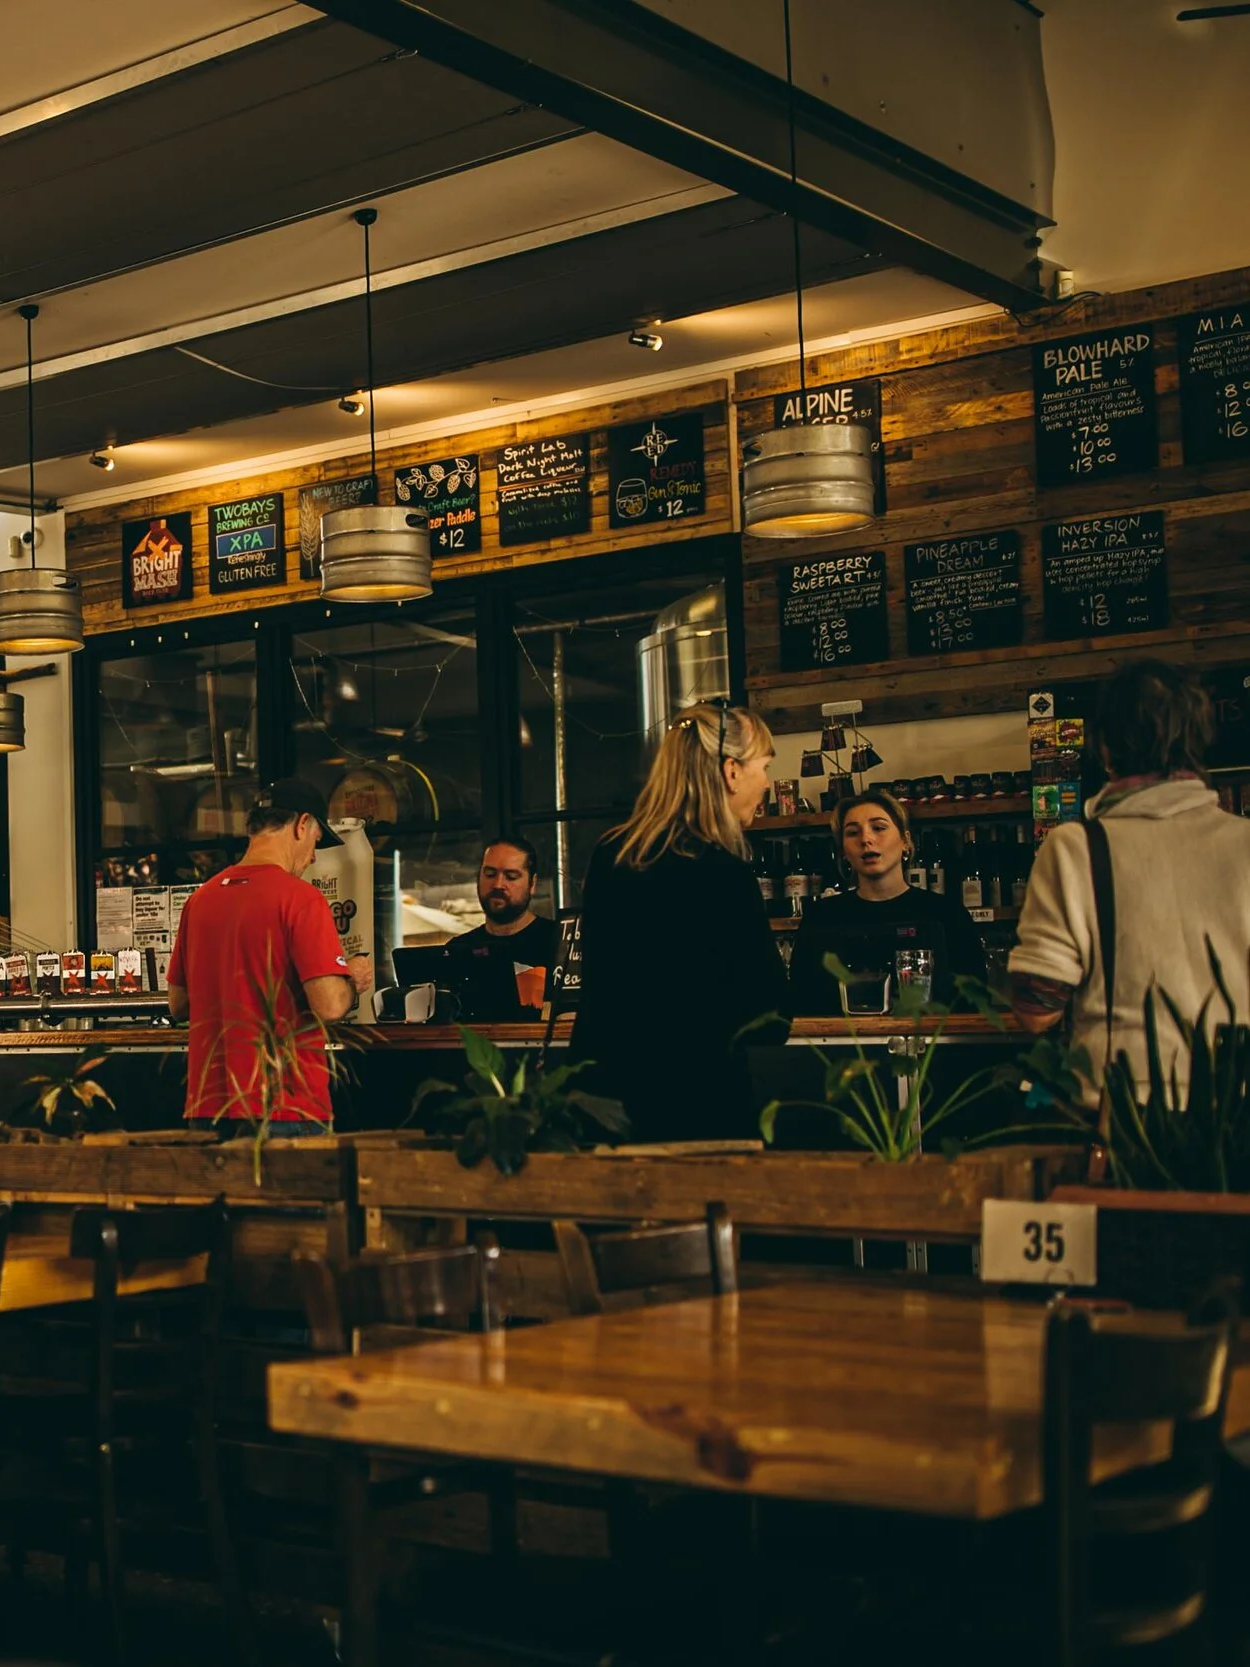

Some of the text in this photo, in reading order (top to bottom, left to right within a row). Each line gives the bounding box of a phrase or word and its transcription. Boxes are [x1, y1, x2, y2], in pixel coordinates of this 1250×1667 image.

[1043, 334, 1150, 369] BLOWHARD
[1055, 360, 1103, 386] PALE
[1041, 387, 1085, 401] American
[1113, 377, 1128, 387] Ale
[782, 388, 854, 421] ALPINE
[498, 449, 583, 474] Dark Night Malt
[504, 440, 566, 461] Spirit Lab
[503, 470, 536, 483] Coffee
[540, 462, 577, 477] Liqueur
[312, 486, 333, 499] NEW
[333, 483, 346, 495] TO
[675, 479, 701, 496] Tonic
[214, 497, 275, 521] TWOBAYS
[428, 493, 476, 513] Craft Beer?
[216, 515, 253, 534] BREWING
[429, 508, 476, 530] zer Paddle
[1057, 516, 1141, 537] INVERSION
[230, 531, 263, 553] XPA
[439, 528, 465, 548] $12
[1061, 533, 1128, 553] HAZY IPA
[916, 538, 998, 563] PINEAPPLE
[218, 563, 277, 584] GLUTEN FREE
[793, 556, 872, 579] RASPBERRY
[937, 555, 984, 574] DREAM
[133, 569, 178, 592] MASH
[790, 570, 866, 593] SWEETART
[1023, 1219, 1066, 1264] 35
